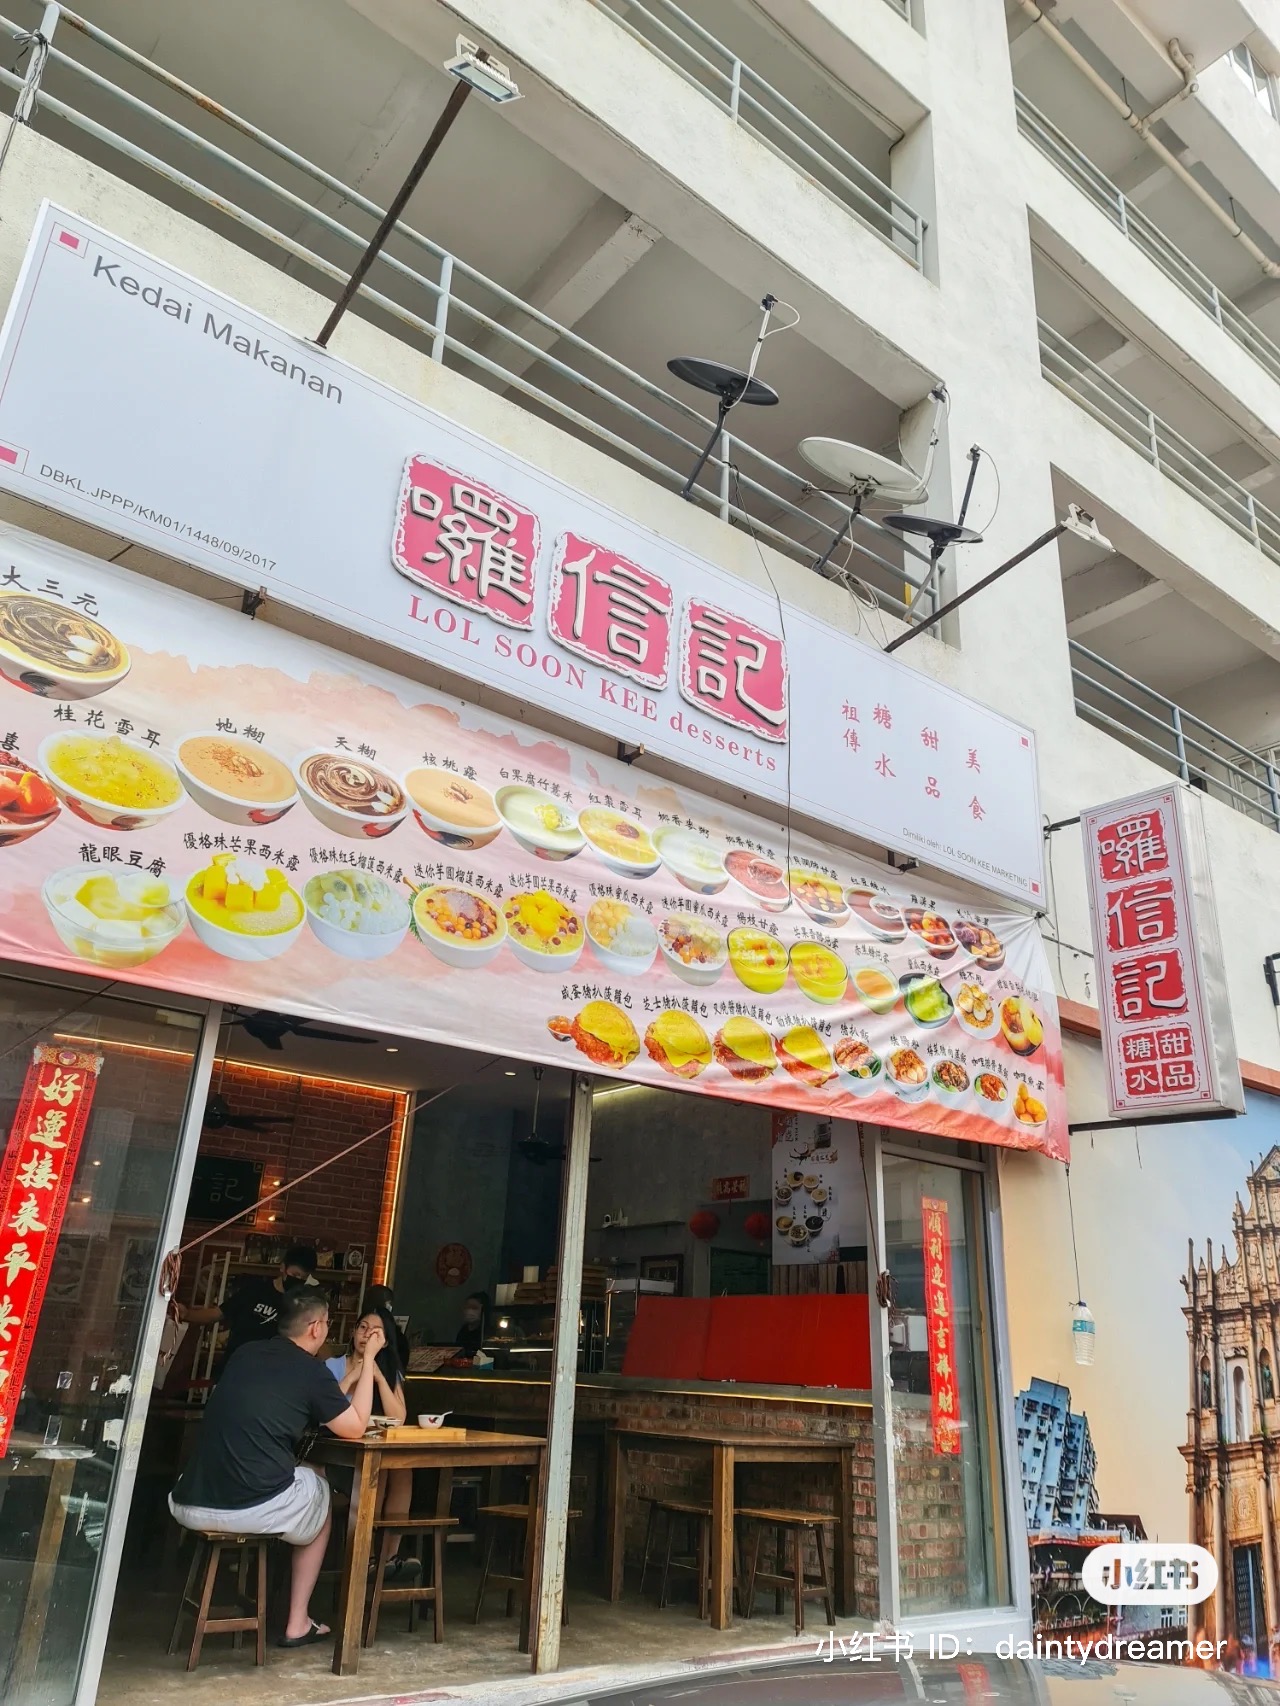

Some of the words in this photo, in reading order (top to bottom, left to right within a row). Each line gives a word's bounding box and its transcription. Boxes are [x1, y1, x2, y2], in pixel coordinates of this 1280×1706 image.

[93, 254, 193, 325] Kedai
[202, 312, 343, 405] Makanan
[39, 464, 277, 572] DBKL.JPPP/KM01/1448/09/2017
[0, 565, 99, 617] 大三元
[407, 593, 480, 646] LOL
[494, 633, 586, 690] SOON
[598, 677, 658, 723] KEE
[669, 711, 777, 772] desserts
[53, 703, 162, 749] 桂花雪耳
[215, 717, 266, 745] 地糊
[335, 736, 377, 760] 天糊
[77, 842, 167, 879] 龍眼豆腐
[943, 844, 956, 857] LOL
[957, 850, 977, 865] SOON
[977, 860, 990, 870] KEE
[991, 865, 1028, 887] MARKETING
